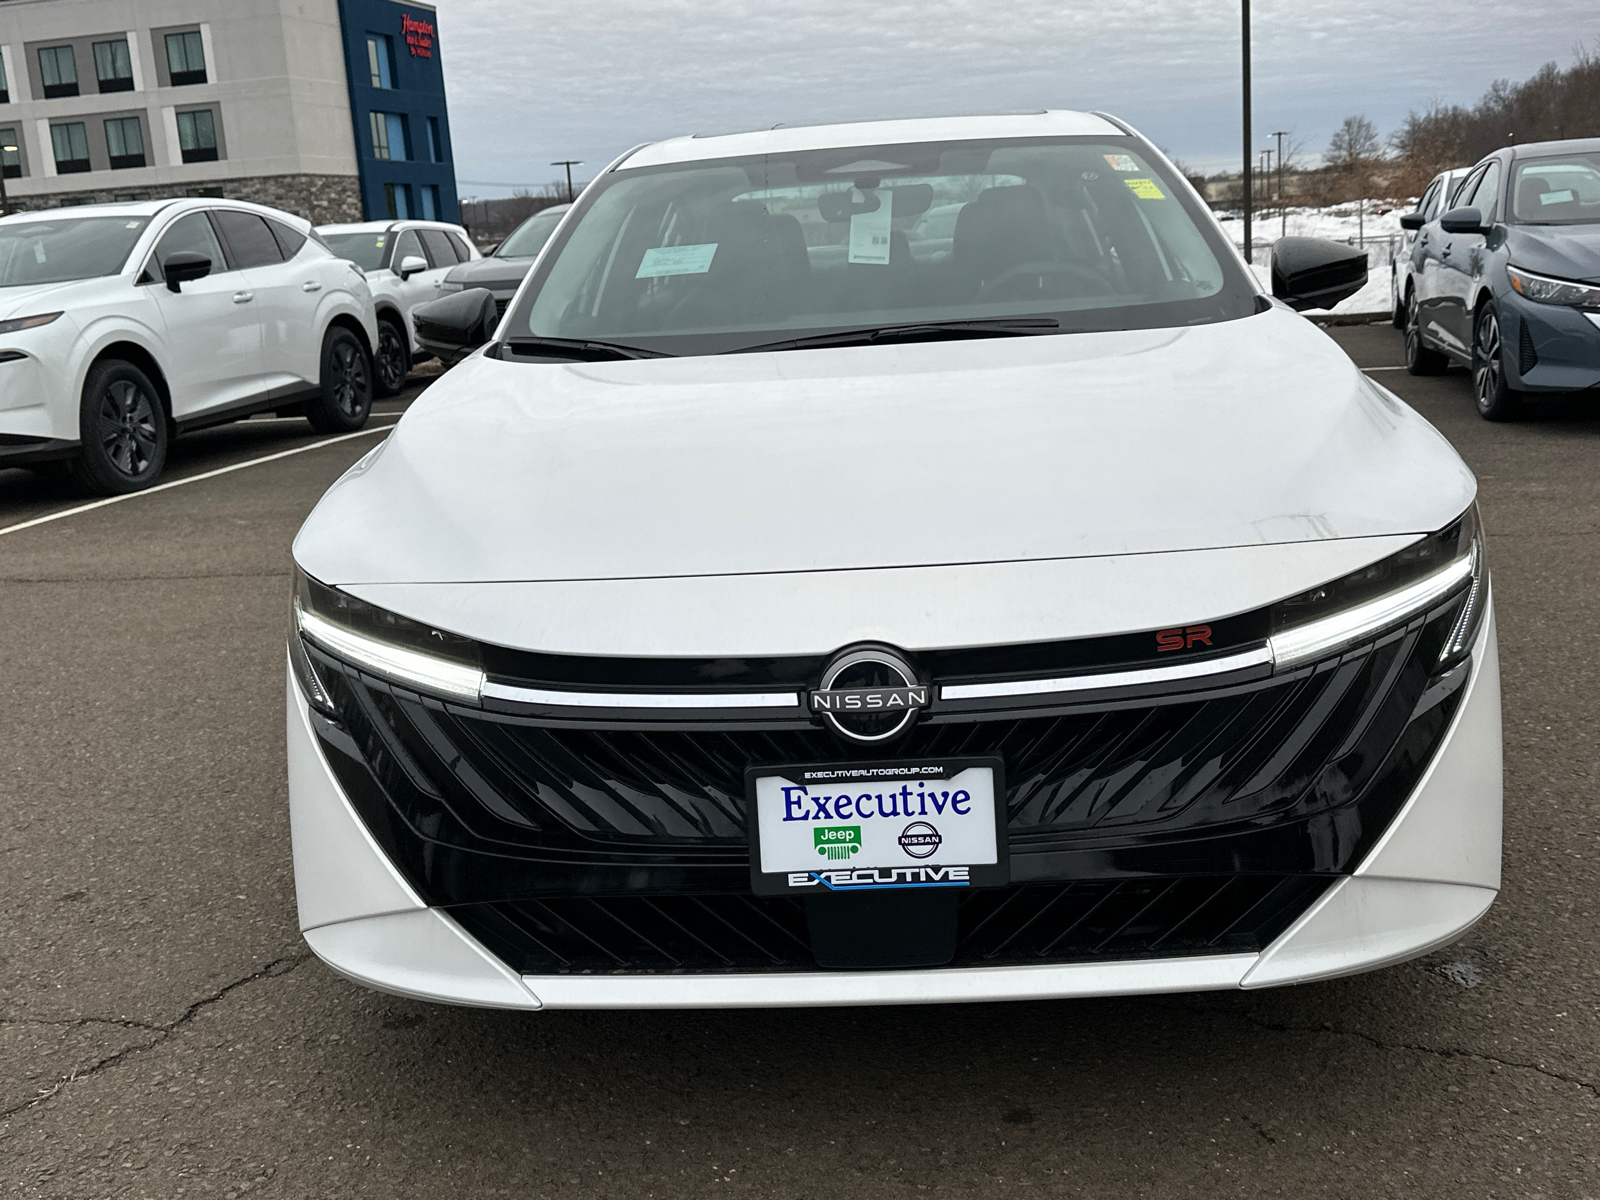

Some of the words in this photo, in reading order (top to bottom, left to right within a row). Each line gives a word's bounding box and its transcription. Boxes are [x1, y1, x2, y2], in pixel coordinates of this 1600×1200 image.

[401, 13, 434, 37] Hampton
[1156, 625, 1213, 652] SR
[813, 690, 925, 709] NISSAN
[804, 766, 944, 779] EXECUTIVEAUTOGROUP.COM
[781, 781, 971, 822] Executive
[820, 829, 855, 842] Jeep
[901, 836, 939, 844] NISSAN
[788, 866, 970, 888] EXECUTIVE
